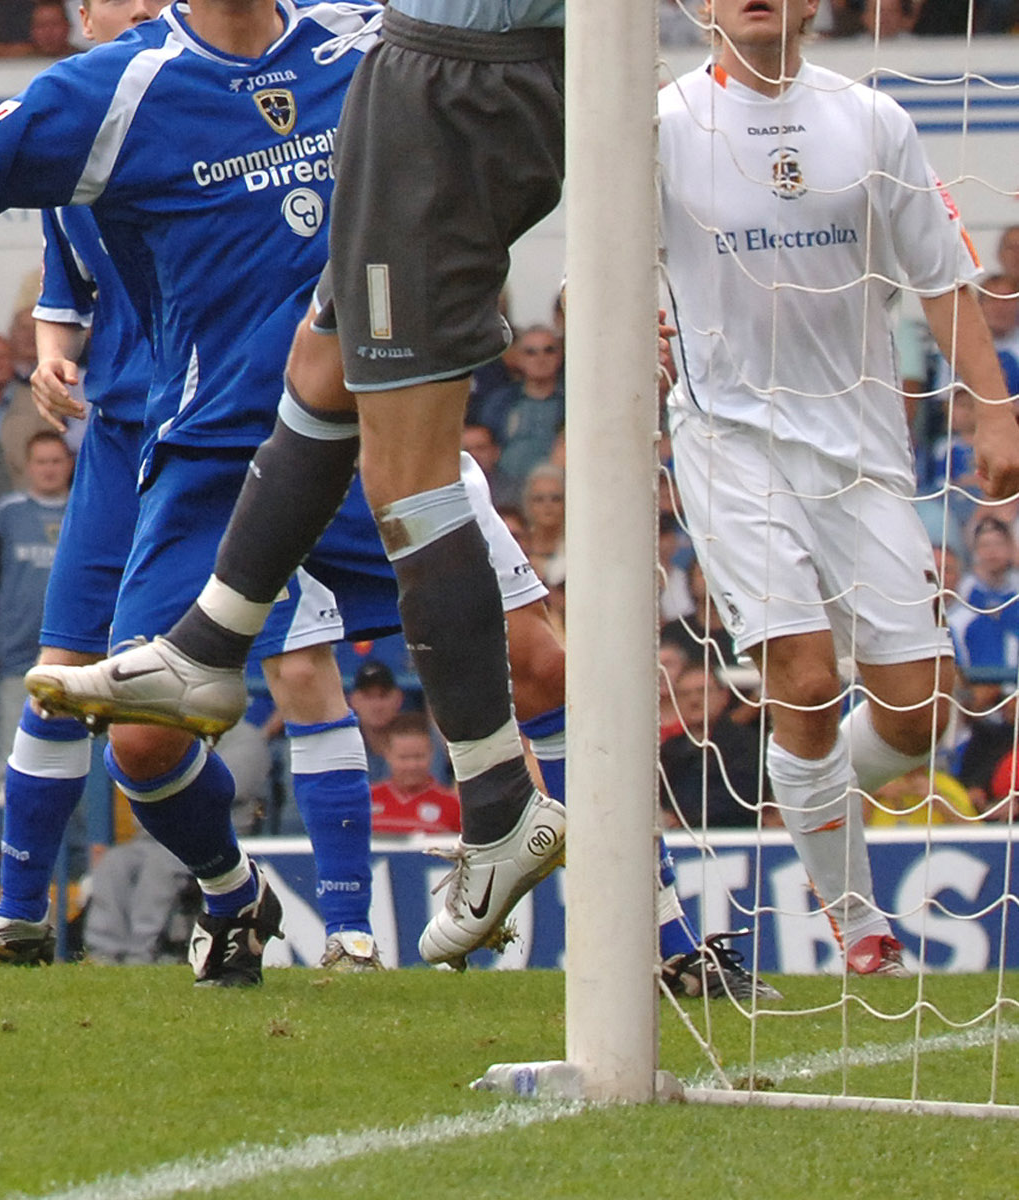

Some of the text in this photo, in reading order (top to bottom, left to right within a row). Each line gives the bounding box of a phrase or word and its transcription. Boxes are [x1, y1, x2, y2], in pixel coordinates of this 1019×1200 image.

[244, 154, 335, 192] Direct
[745, 223, 858, 251] Electrolux
[367, 264, 392, 339] 1
